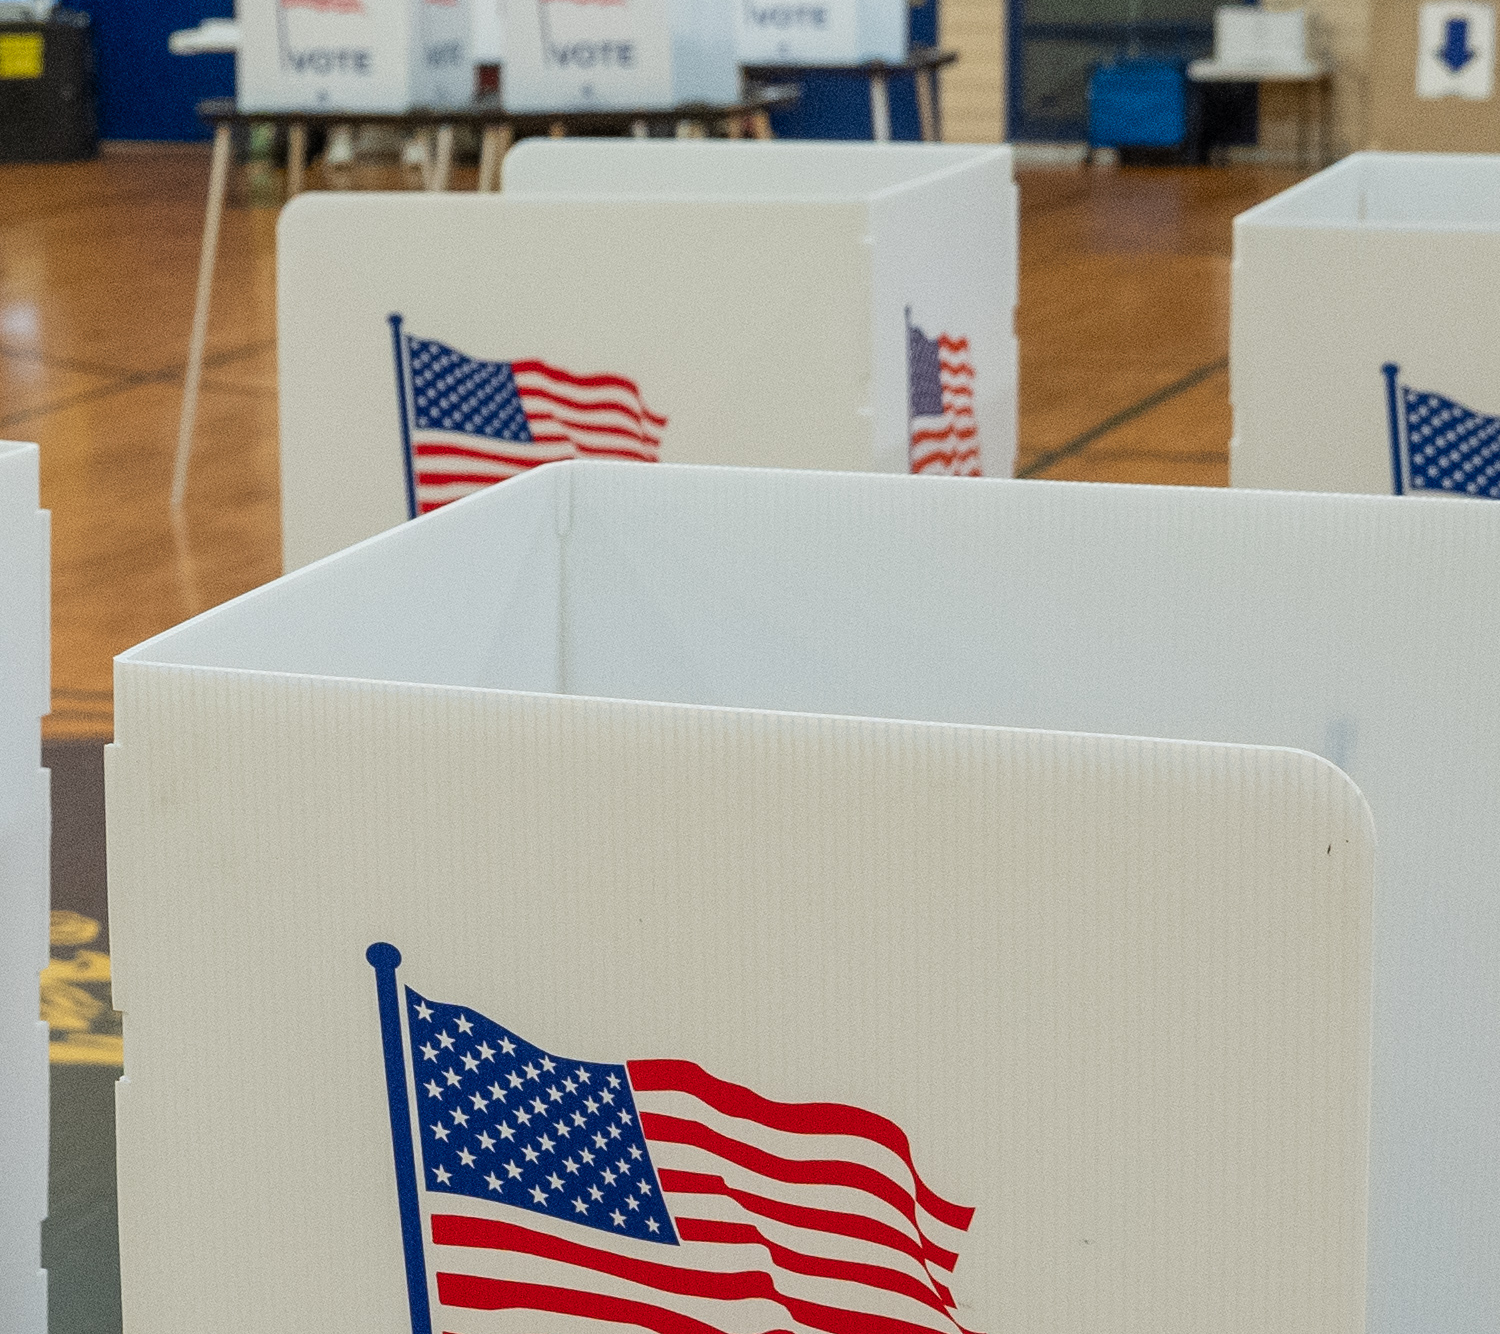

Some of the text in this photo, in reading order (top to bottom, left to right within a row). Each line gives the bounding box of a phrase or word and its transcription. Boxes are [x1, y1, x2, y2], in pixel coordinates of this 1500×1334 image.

[750, 4, 828, 30] VOTE
[287, 45, 371, 76] VOTE
[550, 41, 634, 71] VOTE
